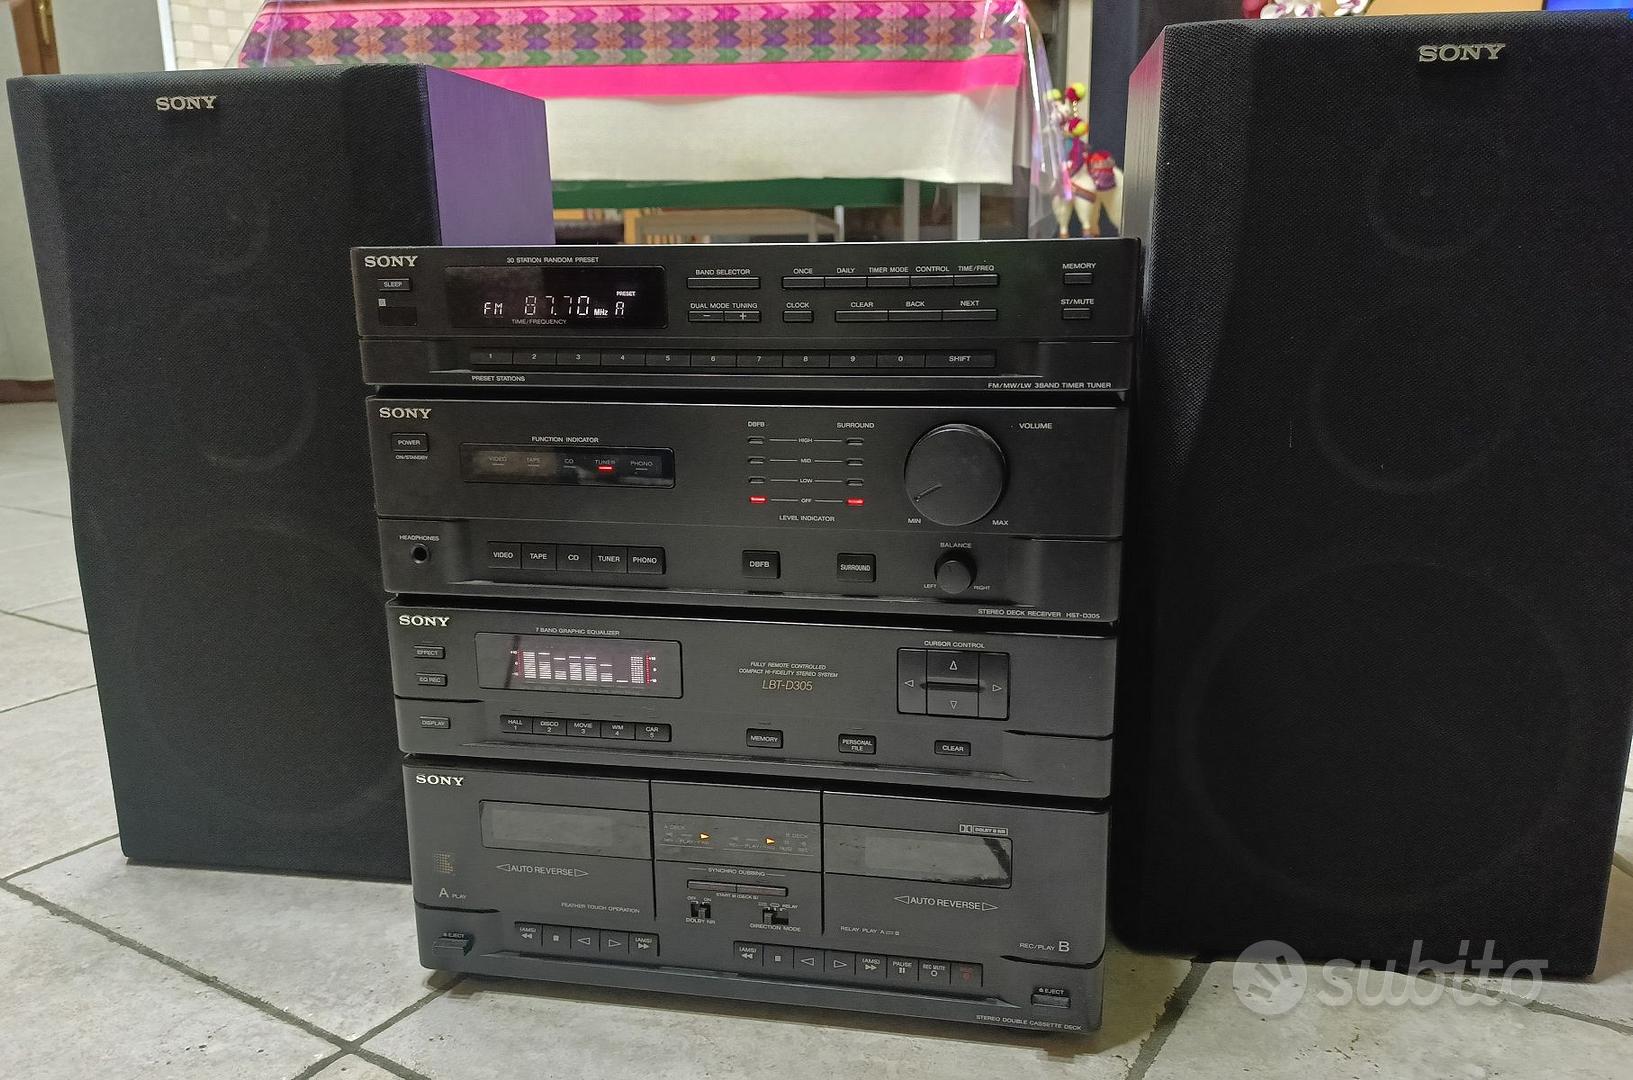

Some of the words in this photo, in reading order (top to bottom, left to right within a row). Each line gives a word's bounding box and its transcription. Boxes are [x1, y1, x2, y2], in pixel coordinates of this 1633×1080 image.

[1417, 43, 1506, 62] SONY
[156, 95, 217, 111] SONY
[364, 256, 418, 268] SONY
[483, 302, 503, 315] FM
[524, 296, 590, 316] 87.70
[615, 302, 624, 316] A
[379, 407, 432, 420] SONY
[632, 556, 657, 564] PHONO
[750, 560, 770, 568] DBFB
[840, 563, 871, 572] SURROUND
[1028, 610, 1061, 618] RECEIVER
[1066, 612, 1100, 620] HST-D305
[399, 615, 450, 628] SONY
[952, 641, 984, 649] CONTROL
[762, 680, 813, 691] LBT-D305
[750, 736, 778, 744] MEMORY
[416, 774, 464, 786] SONY
[511, 864, 533, 874] AUTO
[534, 866, 574, 876] REVERSE
[439, 888, 449, 898] A
[910, 896, 935, 906] AUTO
[937, 898, 981, 910] REVERSE
[750, 922, 780, 930] DIRECTION
[1020, 942, 1056, 951] REC/PLAY
[1058, 940, 1070, 952] B
[1002, 1016, 1028, 1025] DOUBLE
[1029, 1020, 1062, 1029] CASSETTE
[1064, 1023, 1082, 1031] DECK
